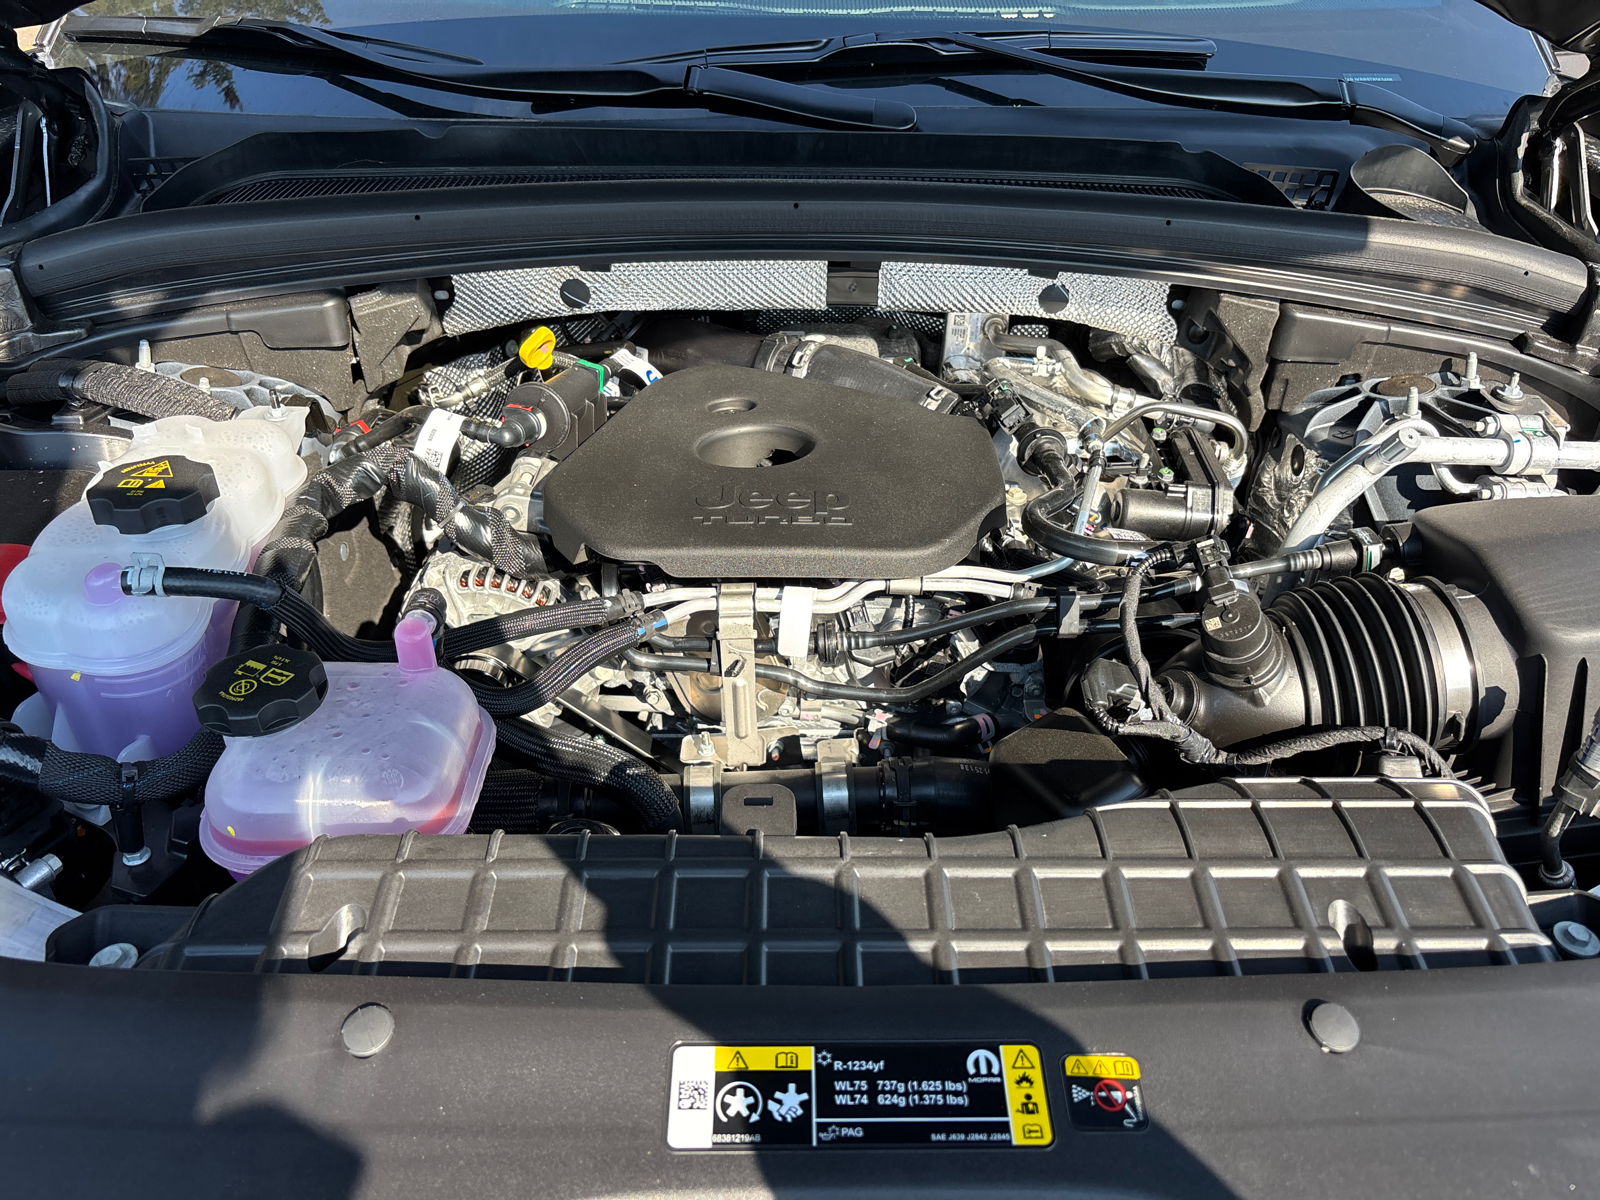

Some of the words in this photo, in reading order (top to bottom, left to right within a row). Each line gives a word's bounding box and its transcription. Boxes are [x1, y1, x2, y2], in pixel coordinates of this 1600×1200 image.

[695, 483, 850, 515] Jeep
[833, 1060, 885, 1073] R-1234yf
[834, 1080, 868, 1092] WL75
[876, 1080, 905, 1093] 737g
[907, 1080, 942, 1093] (1.625
[945, 1080, 968, 1093] lbs)
[967, 1076, 1002, 1084] MOPAR
[834, 1094, 869, 1105] WL74
[877, 1094, 907, 1107] 624g
[909, 1094, 944, 1107] (1.375
[946, 1094, 969, 1107] lbs)
[841, 1127, 864, 1137] PAG
[930, 1133, 947, 1141] SAE
[948, 1133, 965, 1141] J639
